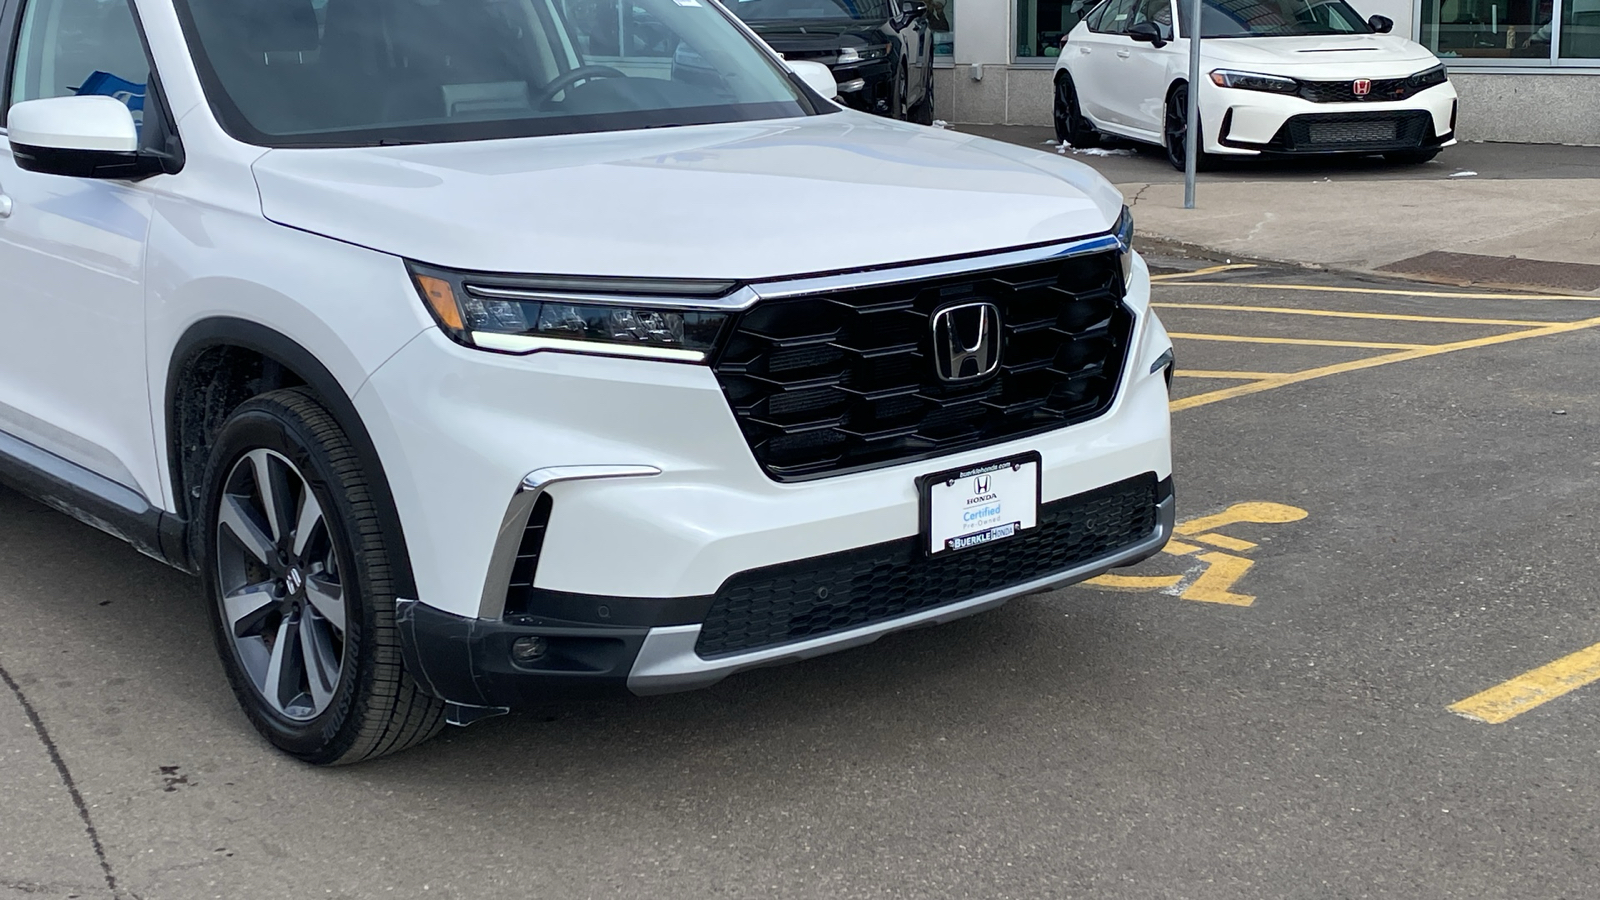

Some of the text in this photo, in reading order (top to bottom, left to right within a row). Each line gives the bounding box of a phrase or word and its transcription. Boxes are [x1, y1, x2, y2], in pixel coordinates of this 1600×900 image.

[966, 493, 997, 505] HONDA
[963, 504, 1001, 522] Certified
[963, 515, 1001, 530] Pre-Owned
[954, 528, 1013, 549] BUERKLE HONDA
